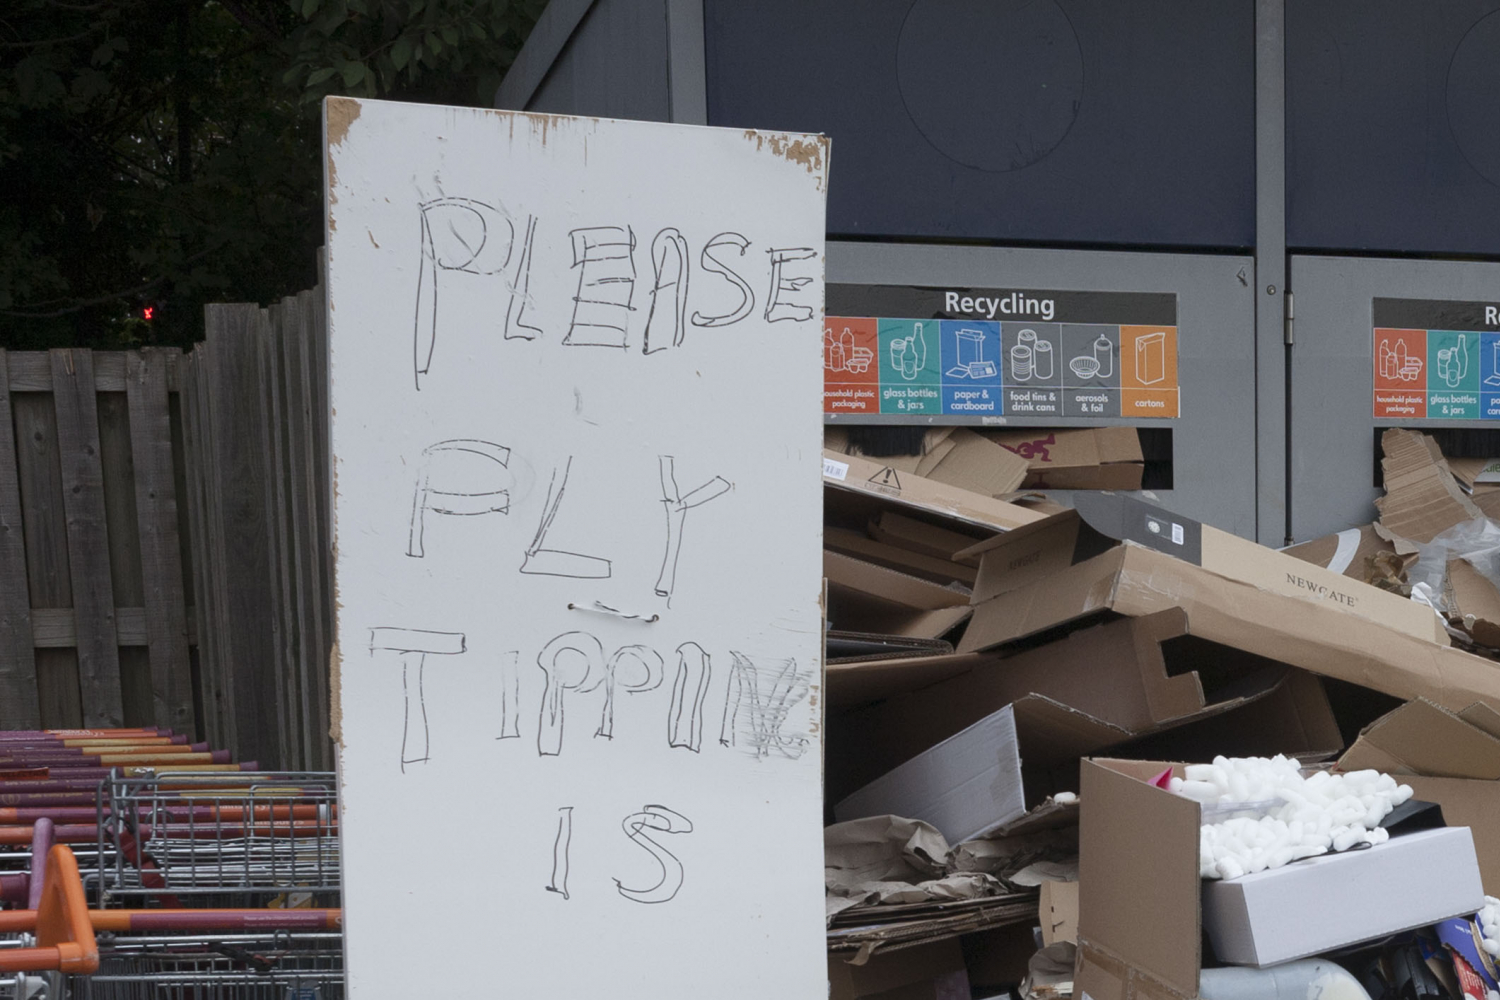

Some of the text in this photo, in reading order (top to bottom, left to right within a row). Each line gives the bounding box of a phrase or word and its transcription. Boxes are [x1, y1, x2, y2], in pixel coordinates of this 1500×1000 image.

[413, 196, 818, 391] PLEASE
[945, 292, 1055, 319] Recycling
[824, 389, 853, 397] ousehold
[884, 388, 937, 399] glass bottles
[954, 390, 989, 402] paper &
[1010, 392, 1056, 402] food tins &
[1076, 394, 1108, 403] aerosols
[1431, 395, 1476, 405] glass bottles
[832, 400, 865, 409] packaging
[898, 400, 923, 411] & jars
[951, 402, 994, 411] cardboard
[1012, 402, 1055, 412] drink cans
[1082, 403, 1103, 413] & foil
[1135, 400, 1165, 408] cartons
[1386, 405, 1414, 414] packaging
[1442, 406, 1464, 416] & jars
[1285, 572, 1357, 607] NEWGATE
[545, 804, 693, 904] IS
